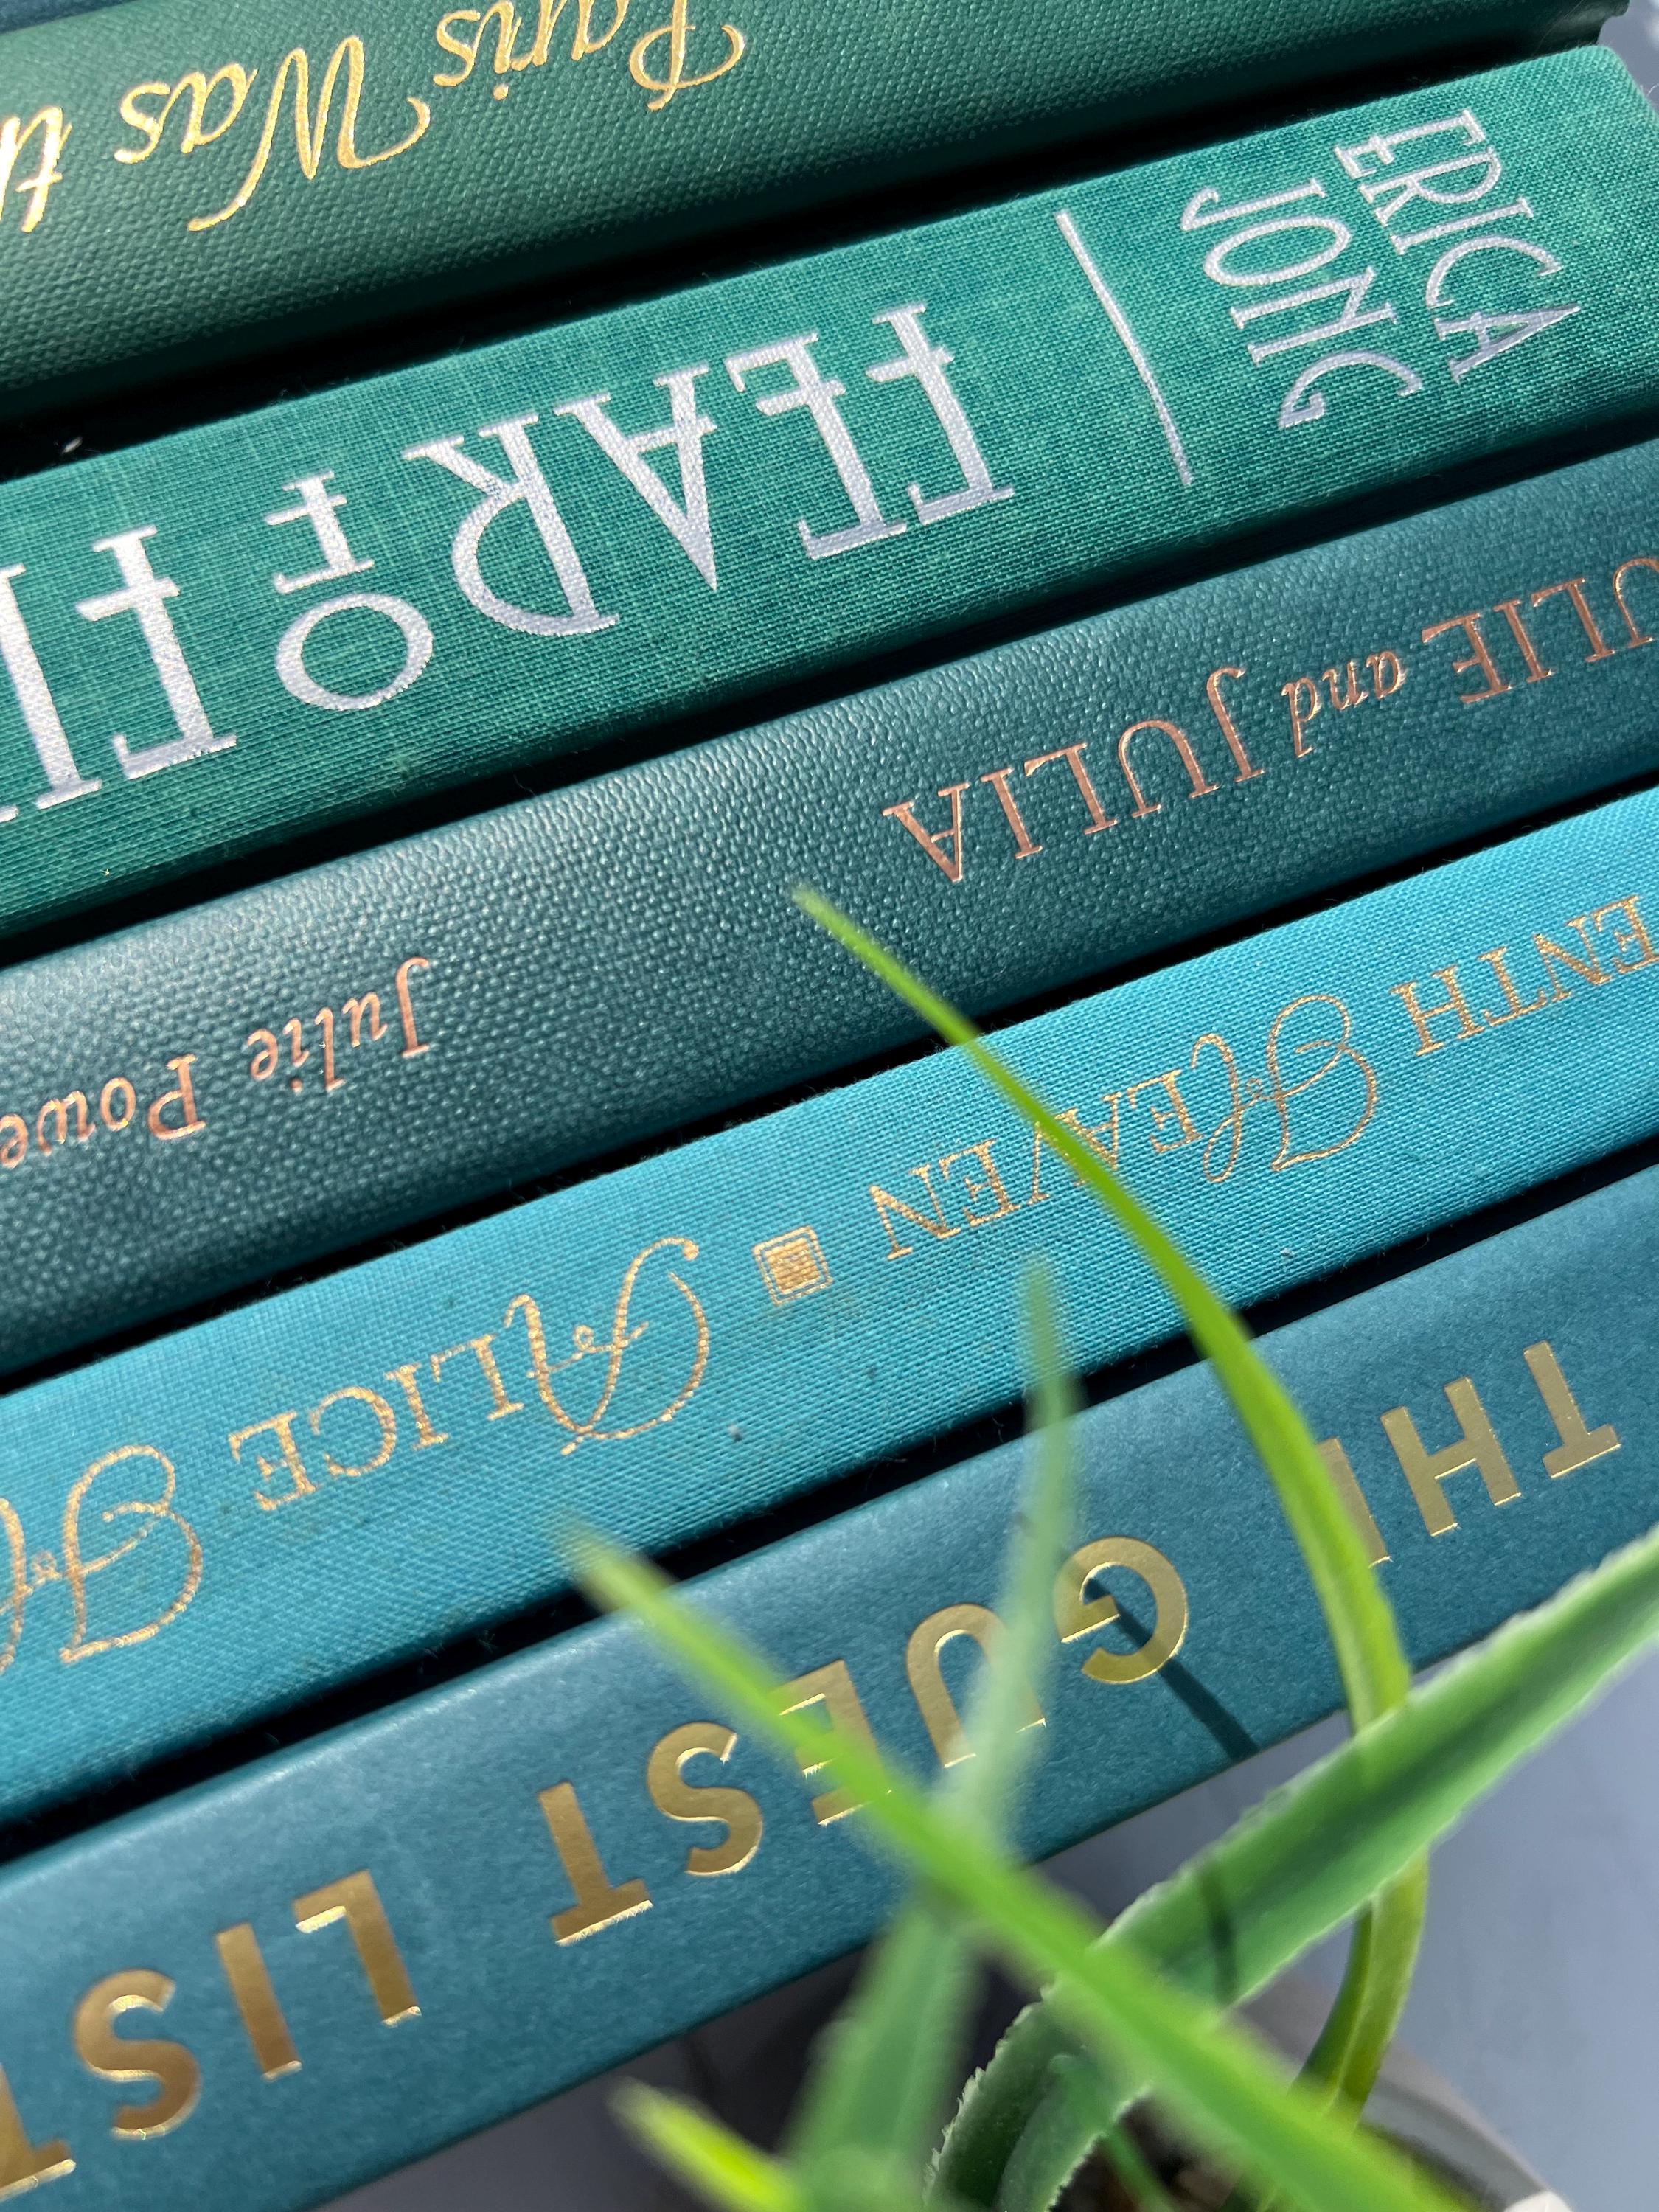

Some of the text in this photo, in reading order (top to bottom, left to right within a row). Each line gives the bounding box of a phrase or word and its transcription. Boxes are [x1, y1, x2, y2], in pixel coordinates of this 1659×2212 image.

[115, 36, 431, 232] Was
[434, 0, 745, 111] Paris
[1180, 178, 1424, 429] JONG
[1334, 108, 1581, 384] ERICA
[0, 302, 1015, 823] FEAR OF FI
[882, 557, 1659, 883] ULIE and JULIA
[0, 957, 430, 1169] Julie Powe
[869, 894, 1659, 1259] ENTH HEAVEN
[228, 1236, 709, 1512] ALICE
[538, 1536, 1189, 1947] GUEST
[0, 1868, 422, 2202] LIST
